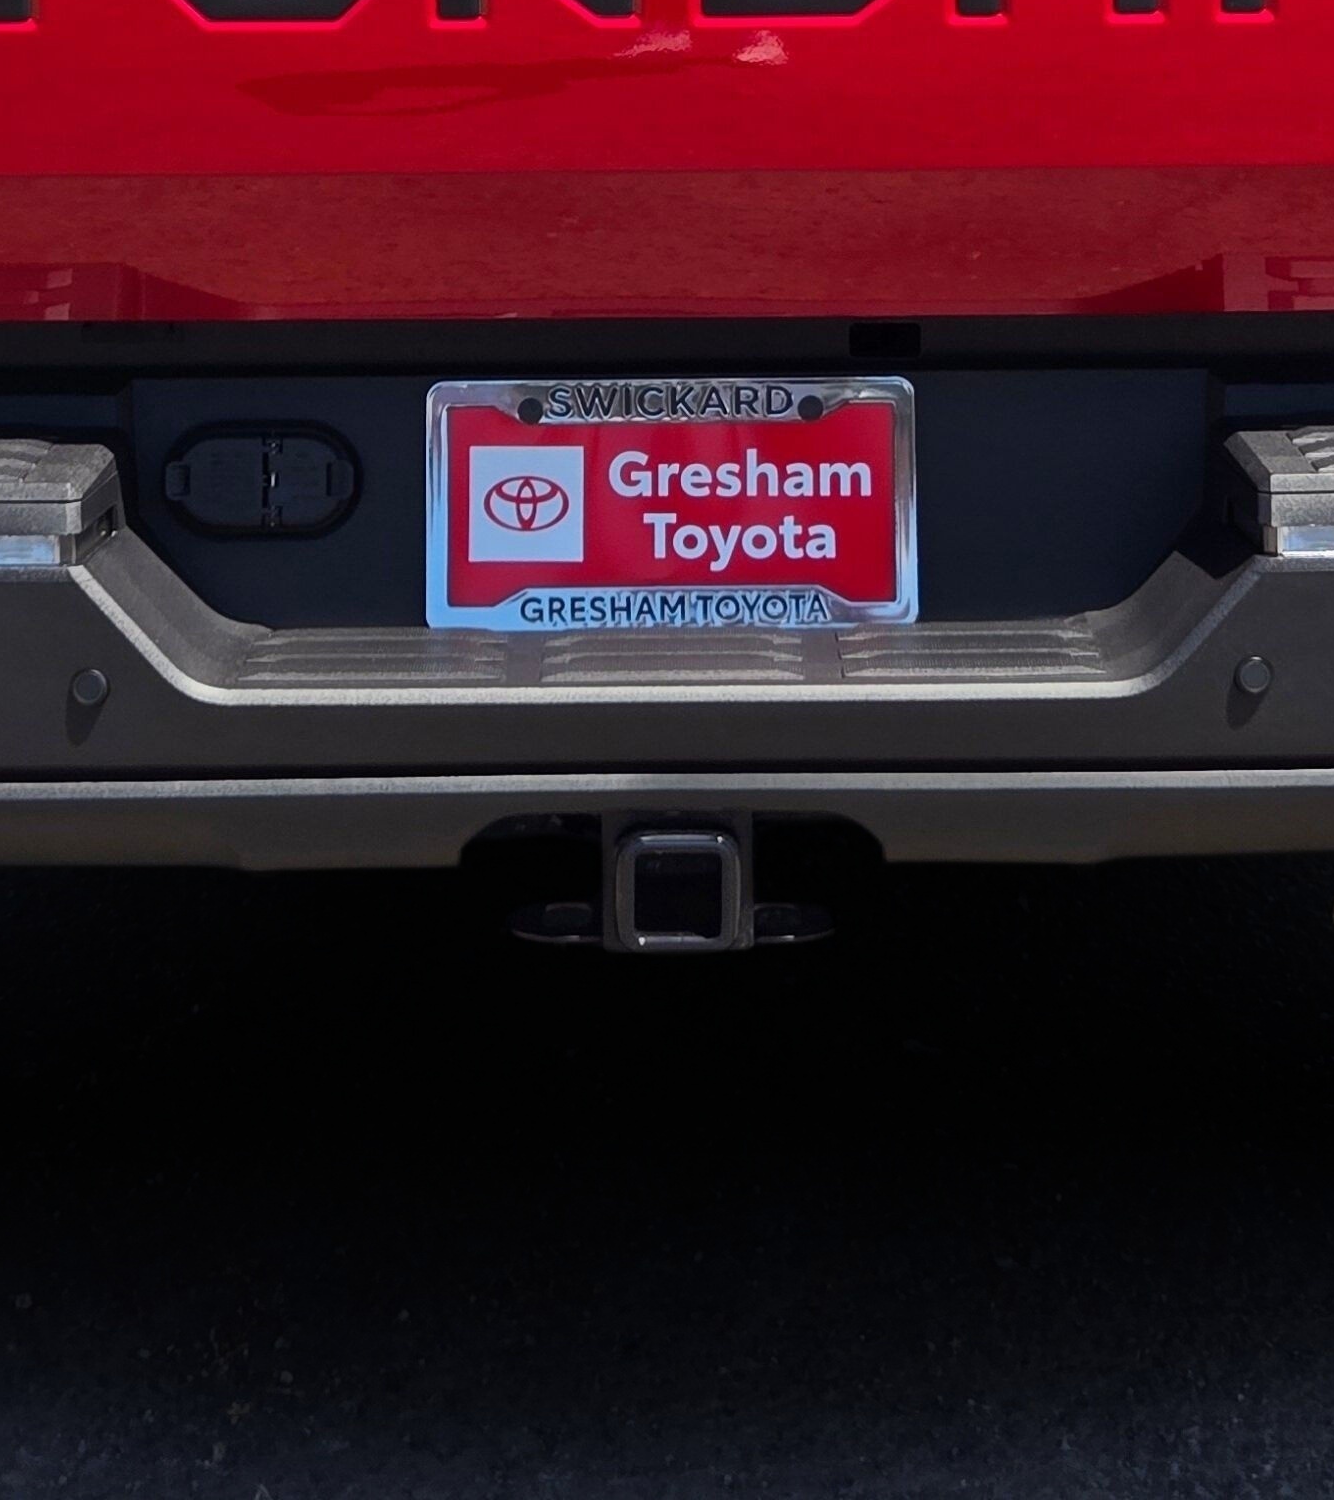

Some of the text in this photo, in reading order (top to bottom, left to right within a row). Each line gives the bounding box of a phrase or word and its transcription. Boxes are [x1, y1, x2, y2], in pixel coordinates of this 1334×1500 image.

[548, 385, 794, 419] SWICKARD
[608, 448, 872, 498] Gresham
[643, 513, 837, 572] Toyota
[520, 594, 829, 623] GRESHAM TOYOTA
